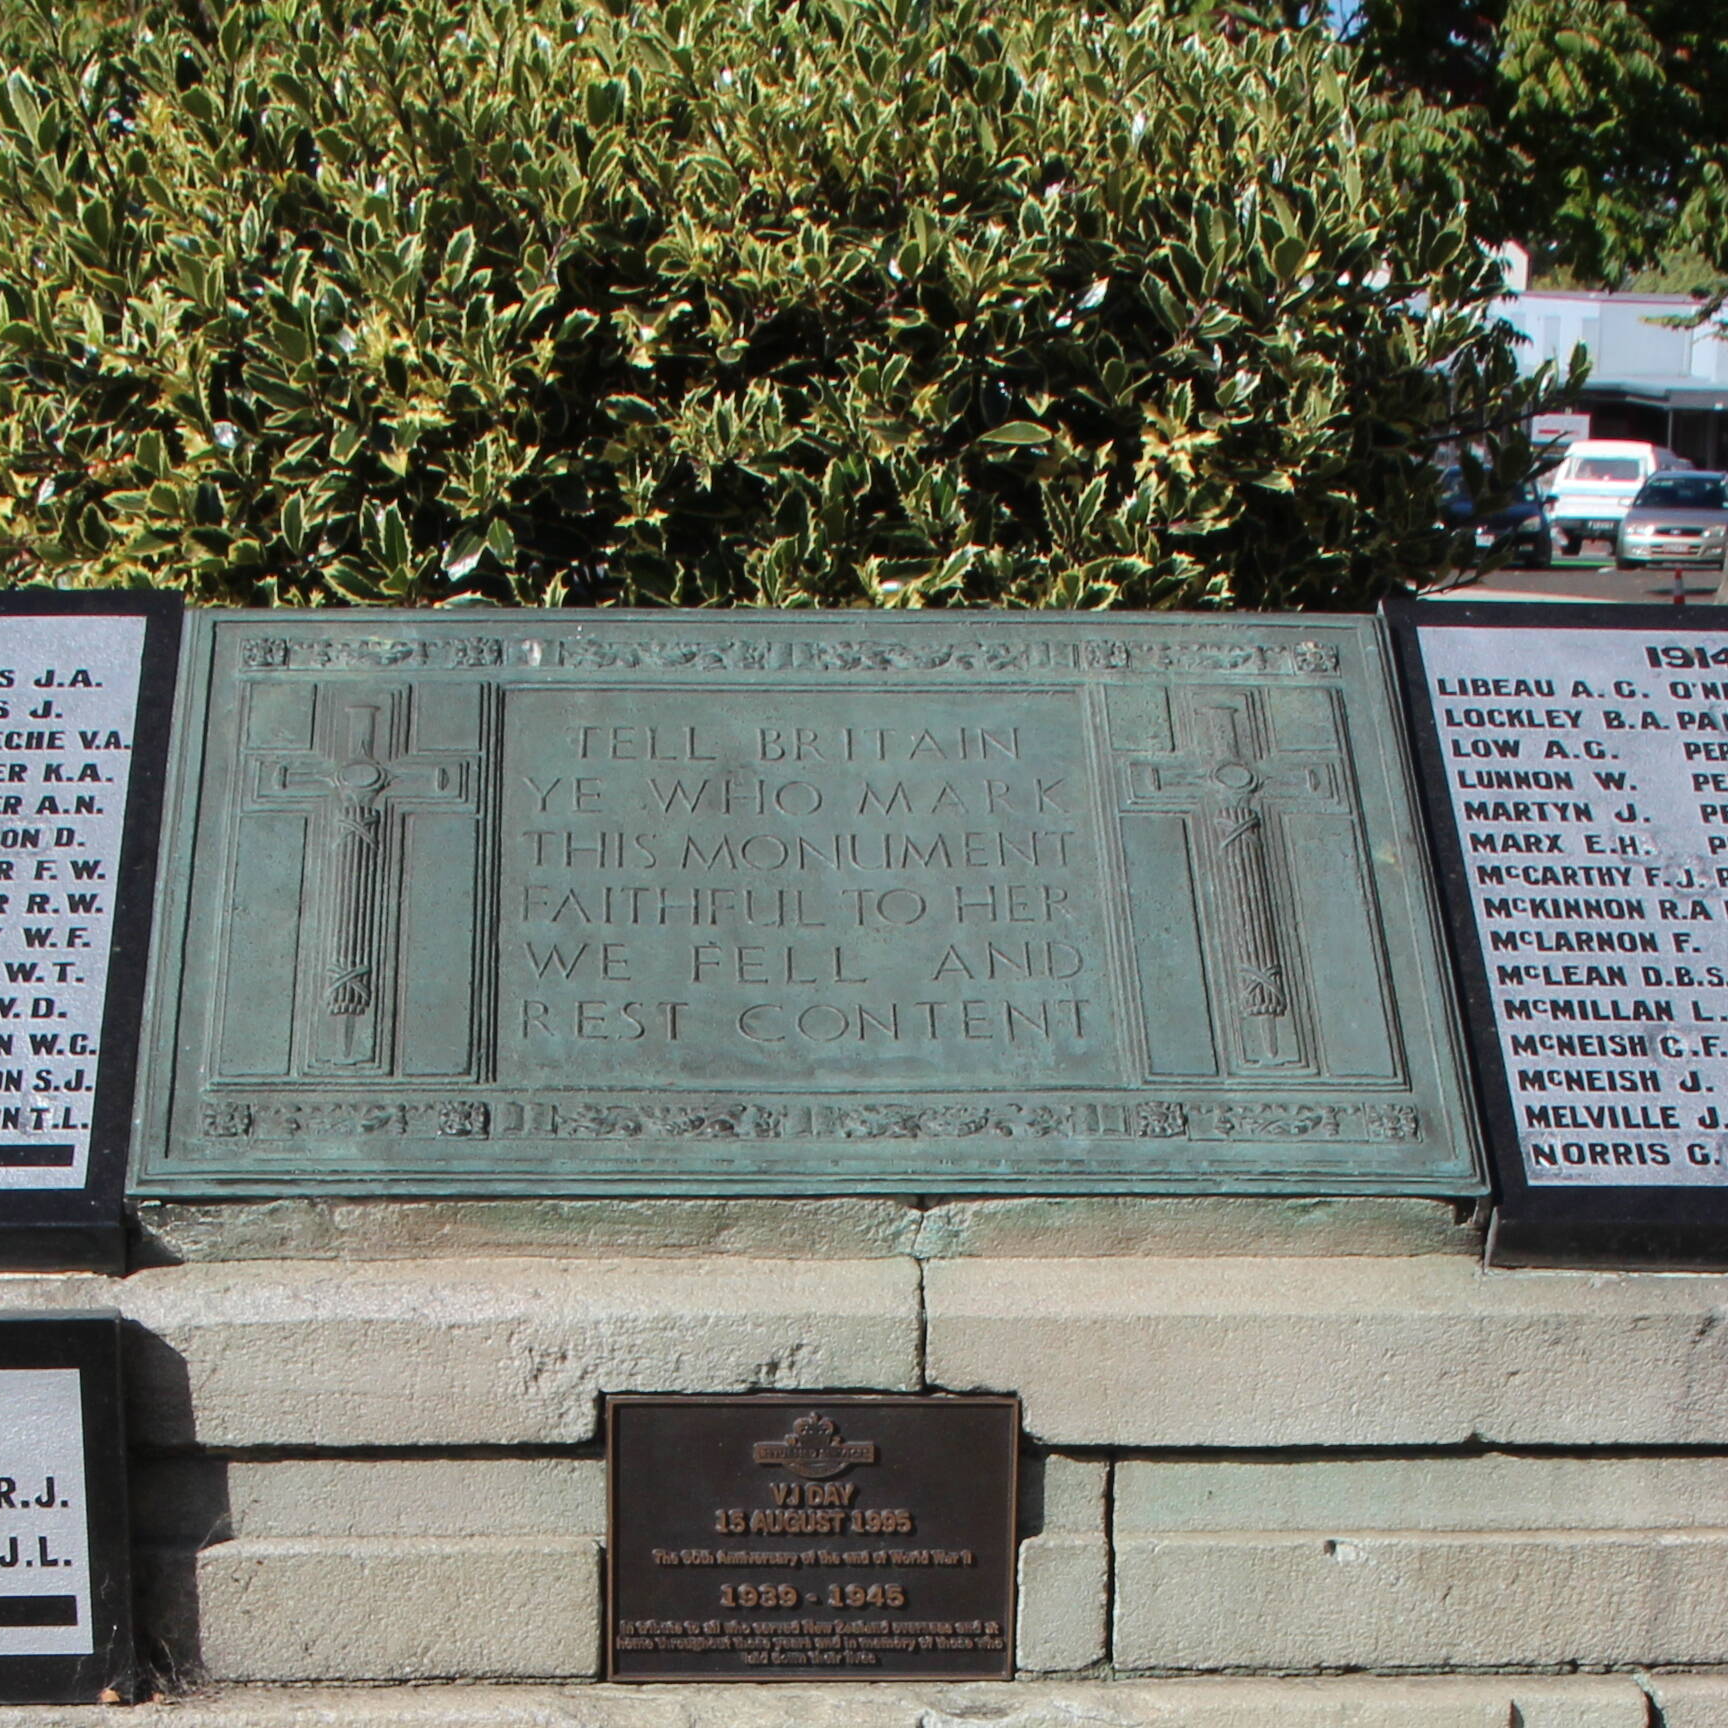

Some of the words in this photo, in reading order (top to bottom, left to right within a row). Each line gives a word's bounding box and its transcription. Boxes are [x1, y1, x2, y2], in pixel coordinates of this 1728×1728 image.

[29, 701, 63, 719] J.
[1445, 709, 1583, 728] LOCKLEY
[570, 724, 716, 764] TELL
[758, 724, 1021, 761] BRITAIN
[1458, 770, 1573, 790] LUNNON
[1594, 772, 1637, 791] W.
[521, 778, 602, 815] YE
[645, 776, 822, 815] WHO
[856, 776, 1068, 813] MARK
[1464, 801, 1593, 822] MARTYN
[1614, 803, 1651, 822] J.
[54, 828, 85, 847] D.
[521, 832, 657, 870] THIS
[682, 831, 1073, 870] MONUMENT
[1470, 834, 1564, 854] MARX
[520, 886, 824, 926] FAITHFUL
[840, 886, 927, 924] TO
[954, 885, 1070, 924] HER
[527, 942, 630, 982] WE
[692, 941, 868, 983] FELL
[933, 941, 1085, 980] AND
[521, 1000, 685, 1041] REST
[738, 999, 1090, 1041] CONTENT
[1525, 1106, 1679, 1129] MELVILLE
[1532, 1143, 1670, 1166] NORRIS
[770, 1482, 800, 1507] VJ
[807, 1481, 856, 1505] DAY
[715, 1509, 745, 1534] 15
[751, 1509, 845, 1533] AUGUST
[851, 1508, 912, 1532] 1995
[719, 1582, 799, 1608] 1939
[828, 1582, 905, 1608] 1945
